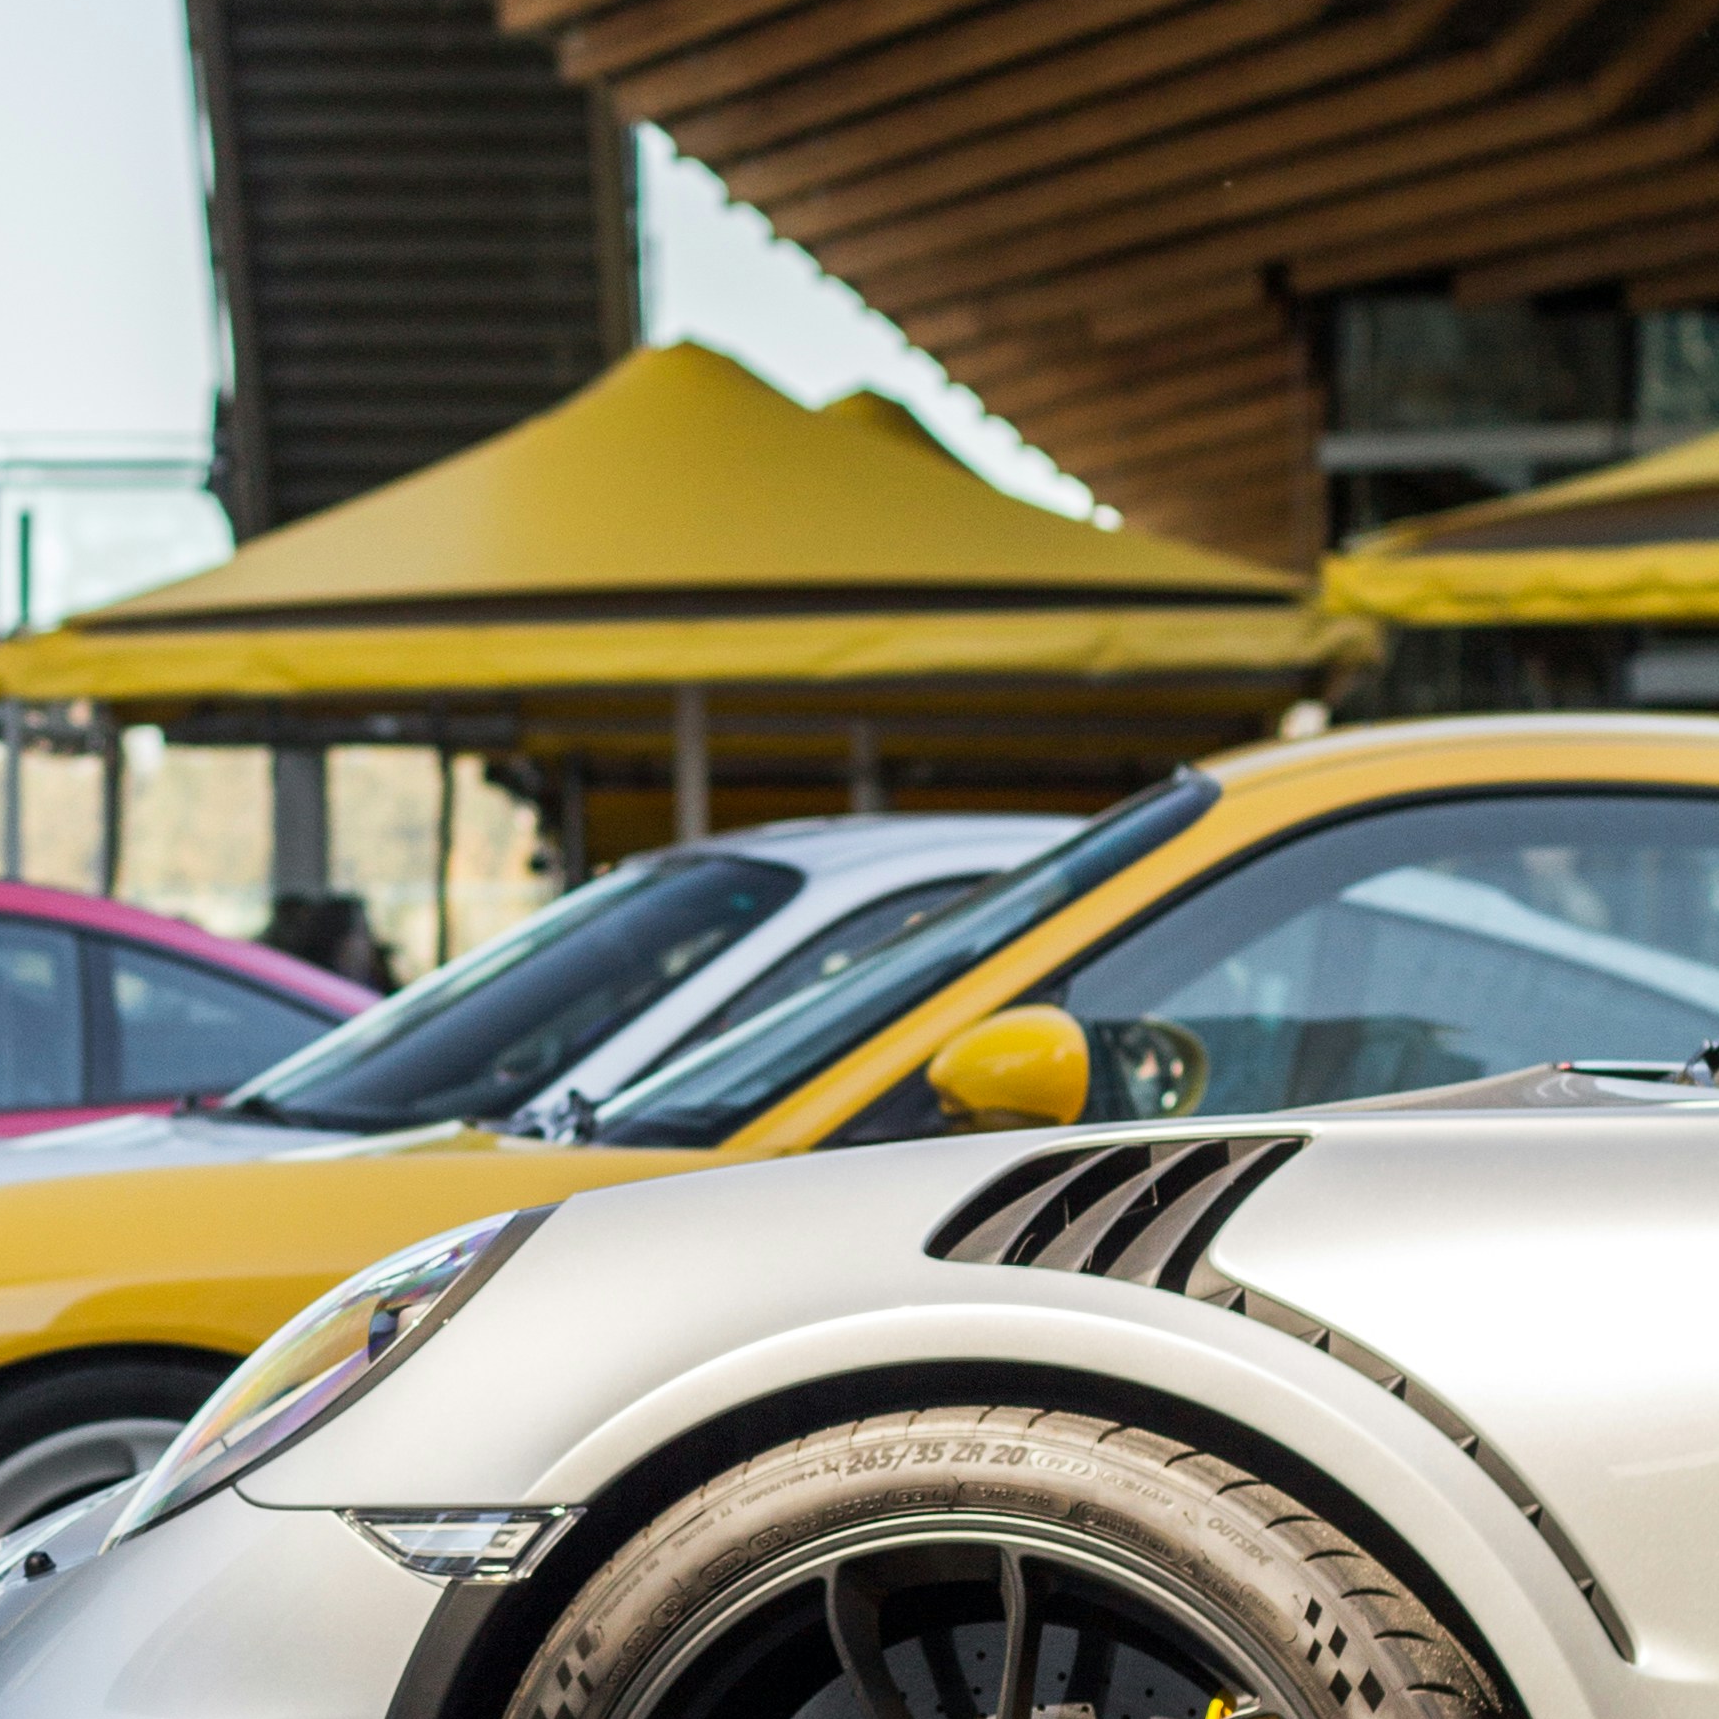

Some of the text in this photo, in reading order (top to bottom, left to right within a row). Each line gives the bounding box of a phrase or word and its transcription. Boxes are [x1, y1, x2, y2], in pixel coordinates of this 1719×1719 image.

[846, 1441, 947, 1475] 265/35
[949, 1441, 987, 1464] ZR
[988, 1445, 1027, 1466] 20
[1206, 1516, 1274, 1567] OUTSIDE
